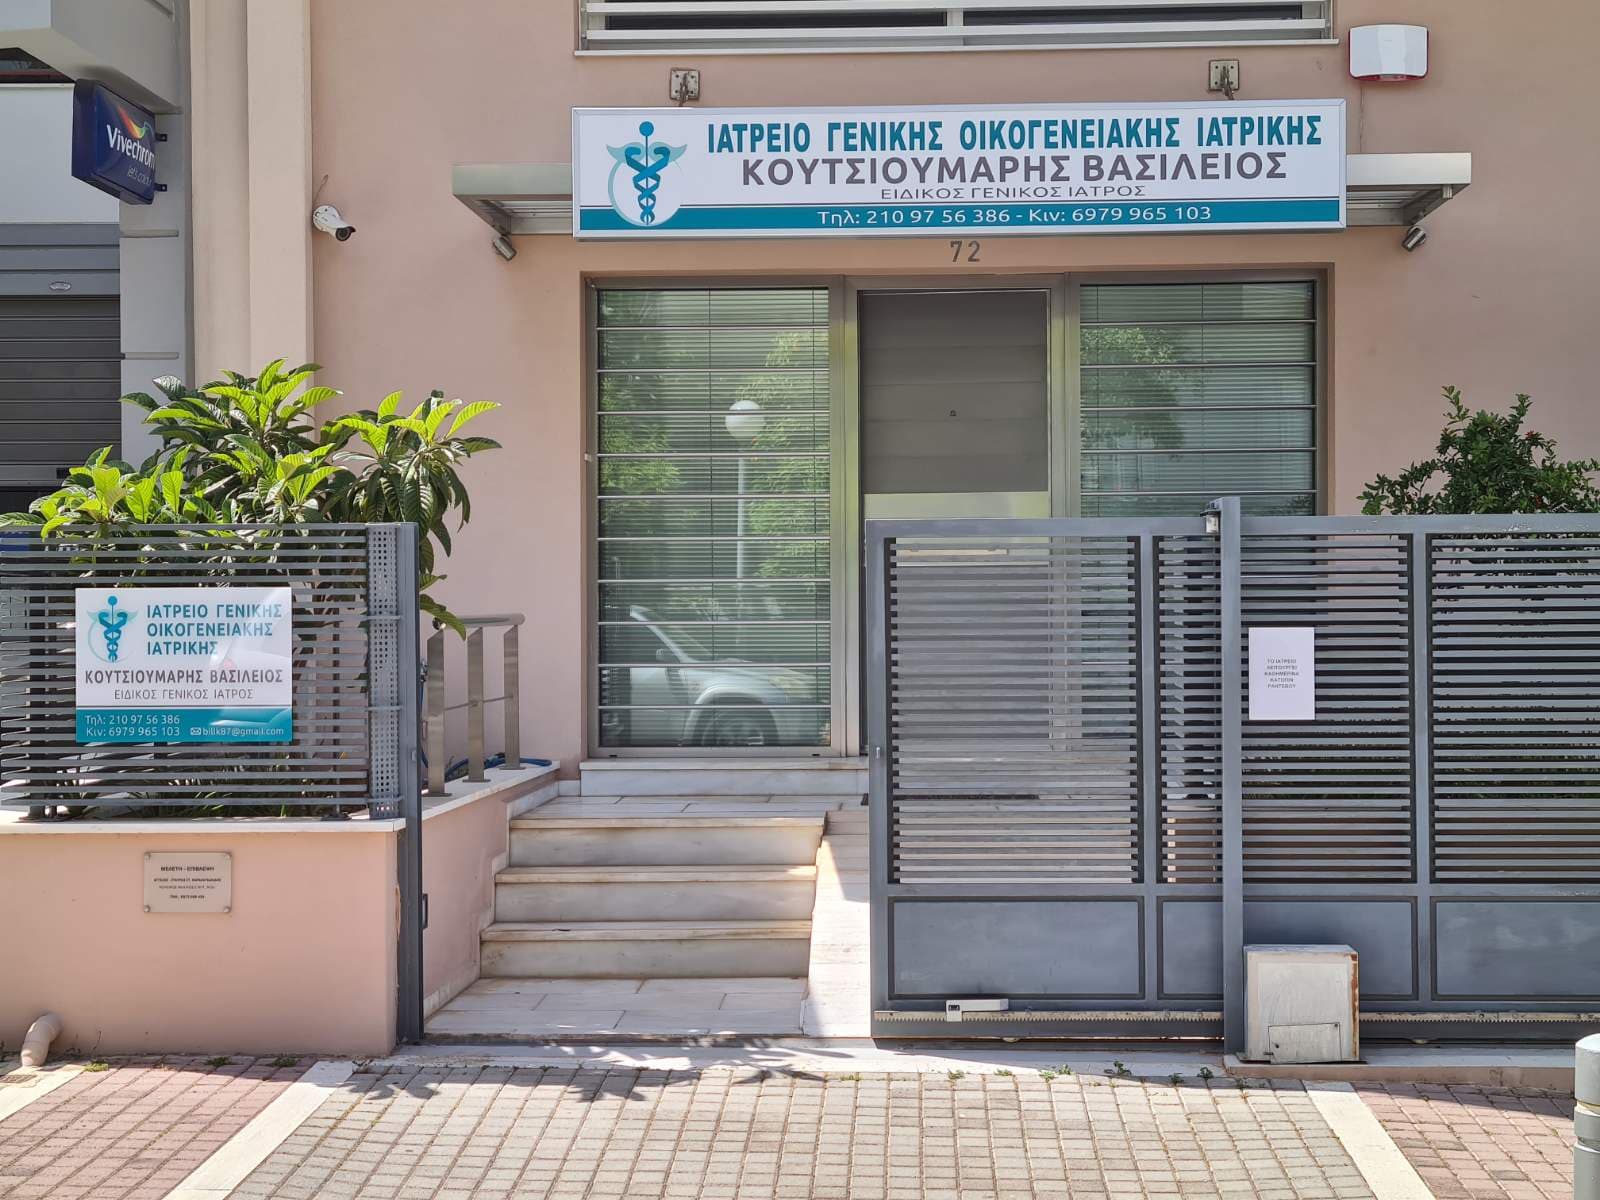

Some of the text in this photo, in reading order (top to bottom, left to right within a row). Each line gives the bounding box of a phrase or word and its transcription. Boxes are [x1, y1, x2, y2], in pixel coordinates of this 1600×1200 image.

[707, 115, 1322, 153] ΙΑΤΡΕΙΟ ΓΕΝΙΚΗΣ ΟΙΚΟΓΕΝΕΙΑΚΗΣ ΙΑΤΡΙΚΗΣ
[742, 151, 1287, 186] ΚΟΥΤΣΙΟΥΜΑΡΗΣ ΒΑΣΙΛΕΙΟΣ
[881, 185, 1146, 200] ΕΙΔΙΚΟΣ ΓΕΝΙΚΟΣ ΙΑΤΡΟΣ
[817, 209, 860, 228] Τηλ:
[866, 210, 904, 224] 210
[910, 209, 934, 224] 97
[941, 209, 966, 223] 56
[972, 209, 1010, 223] 386
[1029, 208, 1065, 222] Κιν:
[1072, 208, 1123, 222] 6979
[1129, 207, 1167, 221] 965
[1175, 206, 1211, 220] 103
[950, 240, 980, 262] 72
[147, 603, 282, 618] ΙΑΤΡΕΙΟ ΓΕΝΙΚΗΣ
[147, 622, 273, 637] ΟΙΚΟΓΕΝΕΙΑΚΗΣ
[147, 641, 218, 656] ΙΑΤΡΙΚΗΣ
[85, 669, 283, 684] ΚΟΥΤΣΙΟΥΜΑΡΗΣ ΒΑΣΙΛΕΙΟΣ
[114, 689, 253, 700] ΕΙΔΙΚΟΣ ΓΕΝΙΚΟΣ ΙΑΤΡΟΣ
[85, 715, 180, 727] Τηλ: 210 97 56 386
[86, 728, 180, 737] Κιν: 6979 965 103
